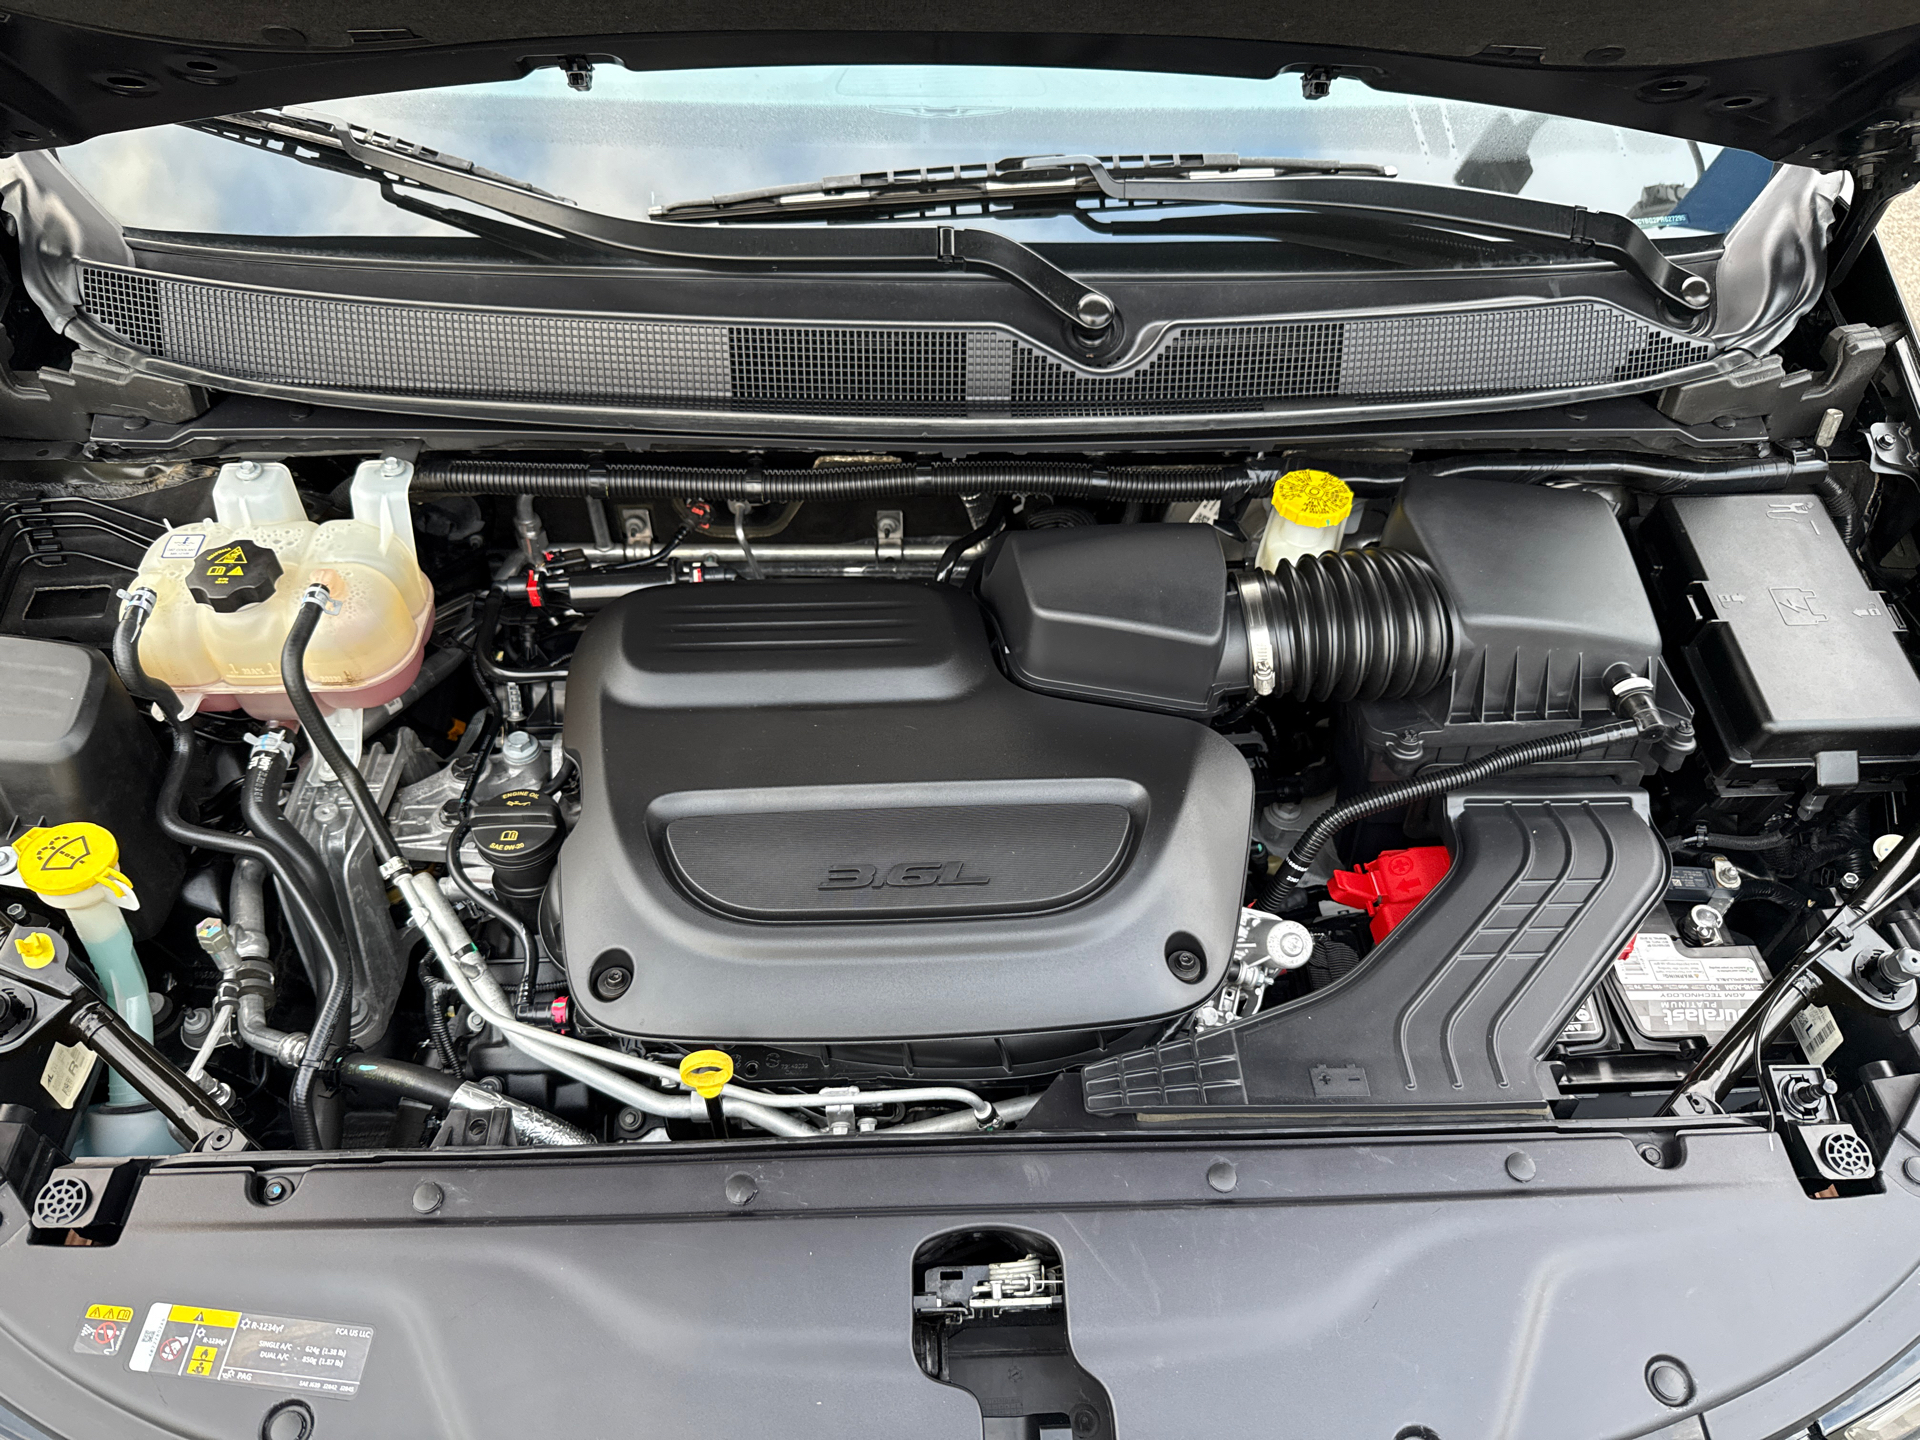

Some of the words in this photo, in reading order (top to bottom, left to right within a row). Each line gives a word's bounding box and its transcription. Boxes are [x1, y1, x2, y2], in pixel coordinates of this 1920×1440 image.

[502, 791, 529, 799] ENGINE
[529, 792, 540, 800] OIL
[489, 842, 504, 851] SAE
[818, 861, 991, 891] 3.6L
[251, 1321, 285, 1334] R-1234yf
[335, 1327, 348, 1336] FCA
[349, 1329, 359, 1337] US
[359, 1330, 371, 1338] LLC
[258, 1340, 280, 1349] SINGLE
[280, 1342, 293, 1351] A/C
[304, 1345, 320, 1355] 624g
[337, 1349, 347, 1358] lb)
[259, 1350, 277, 1360] DUAL
[276, 1352, 290, 1361] A/C
[334, 1359, 344, 1368] lb)
[236, 1371, 253, 1381] PAG
[299, 1380, 309, 1388] SAE
